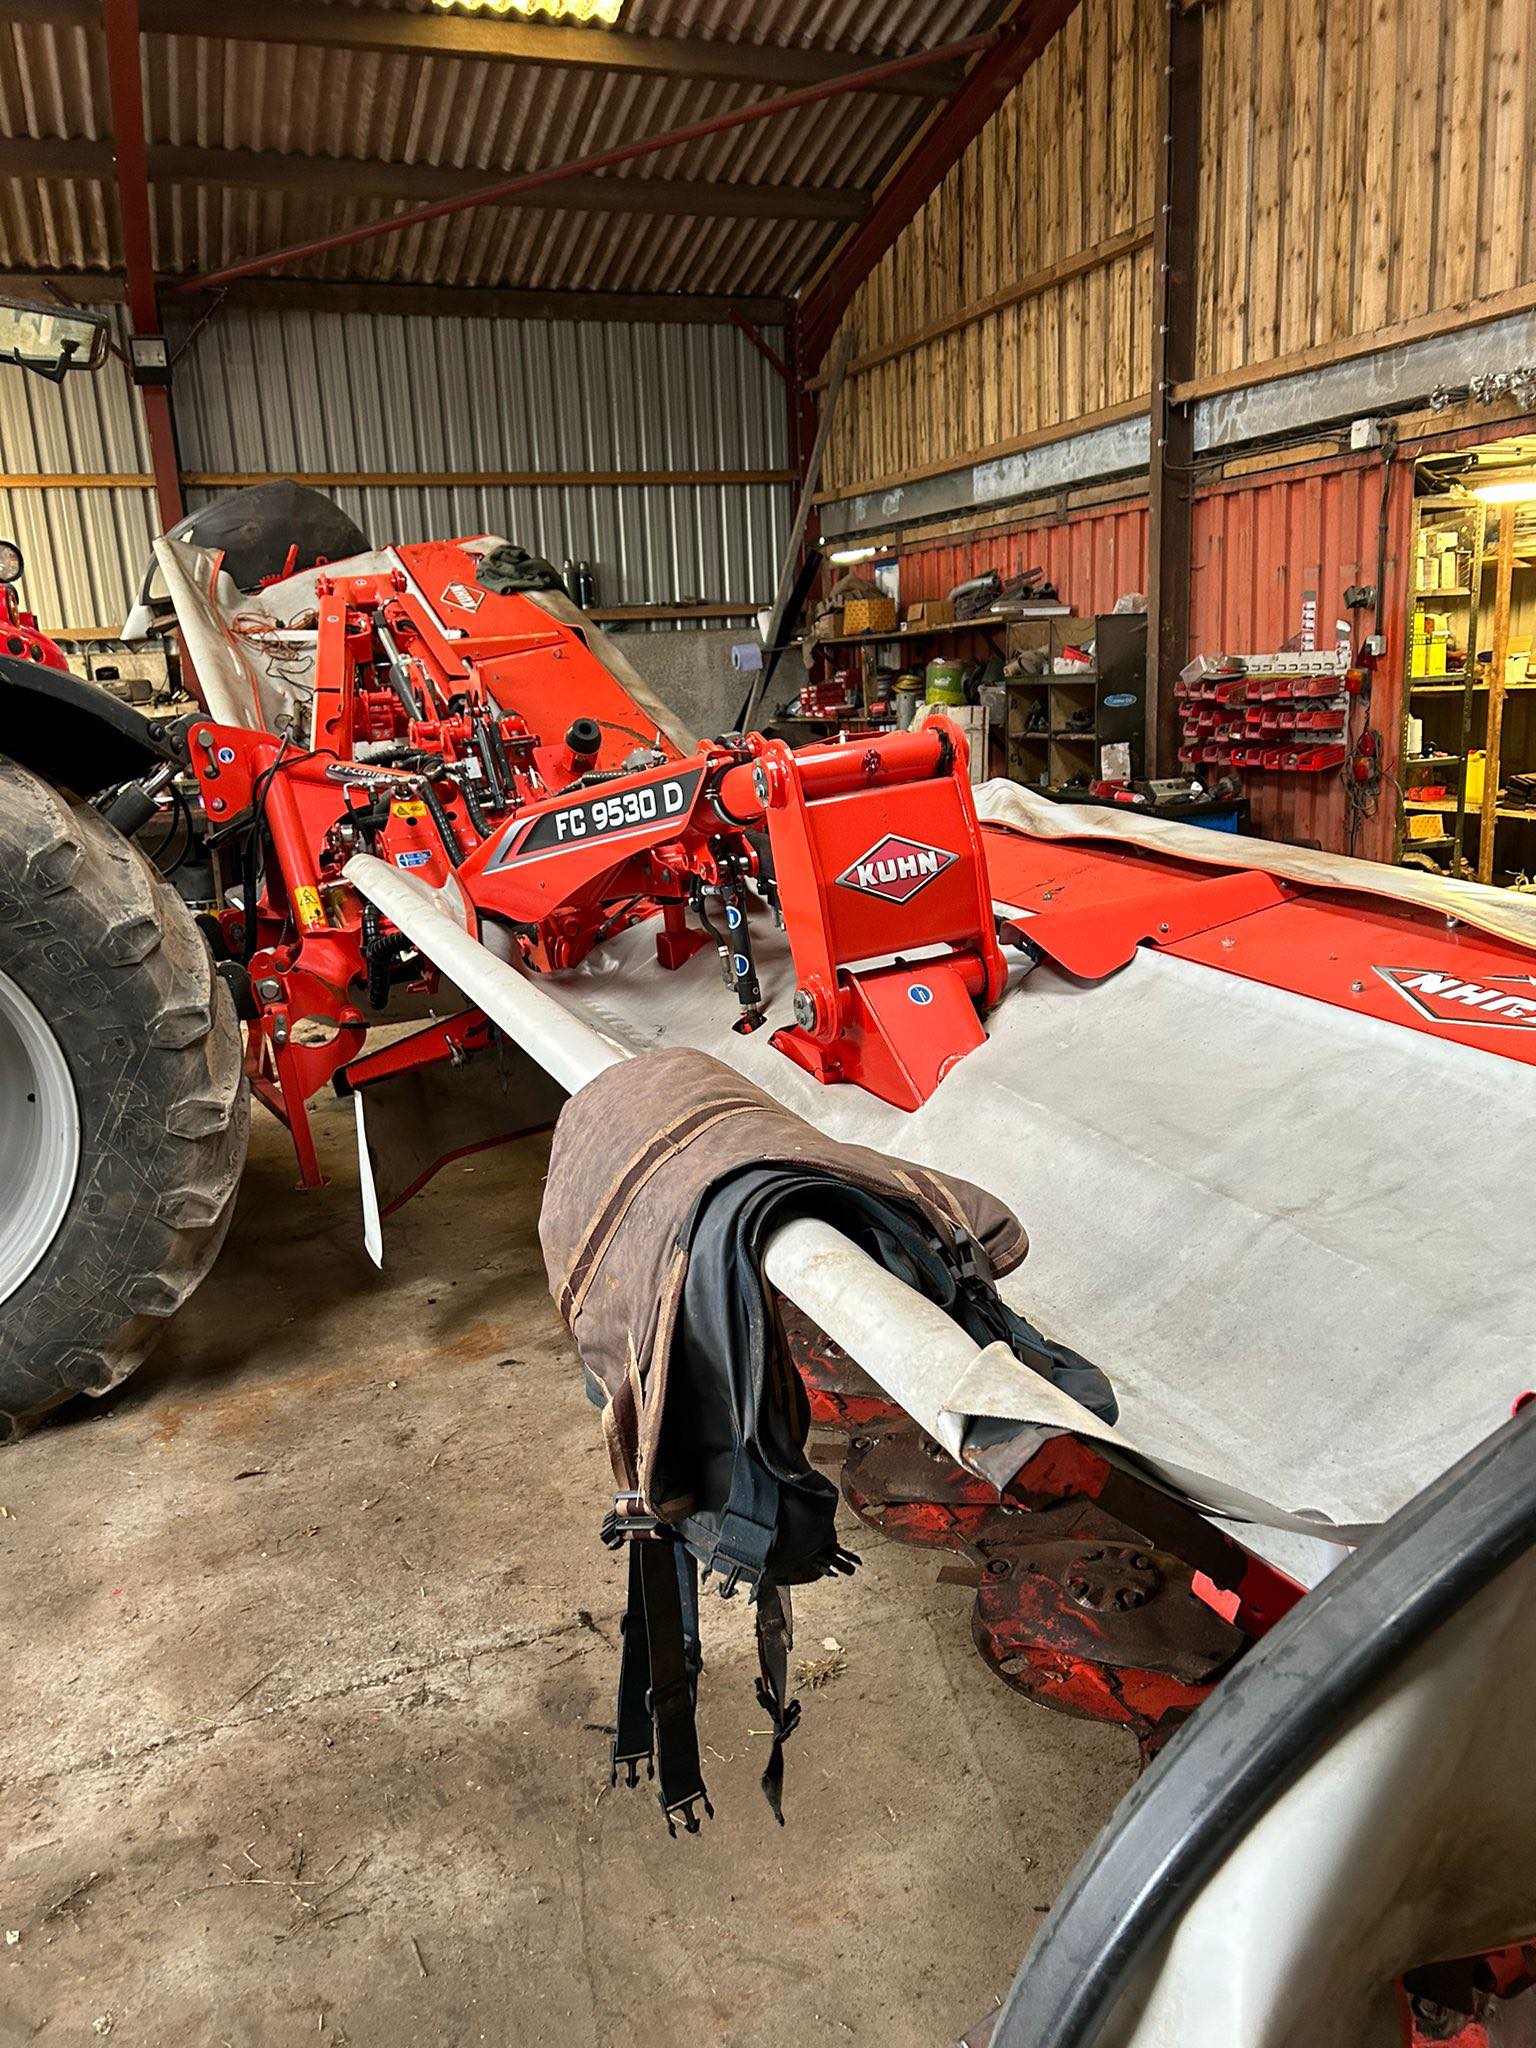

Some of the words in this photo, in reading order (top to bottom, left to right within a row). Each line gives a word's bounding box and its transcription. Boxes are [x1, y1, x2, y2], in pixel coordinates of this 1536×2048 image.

[555, 808, 587, 840] FC
[591, 788, 657, 830] 9530
[662, 781, 684, 813] D
[856, 850, 940, 887] KUHN
[1399, 972, 1536, 1024] UHN
